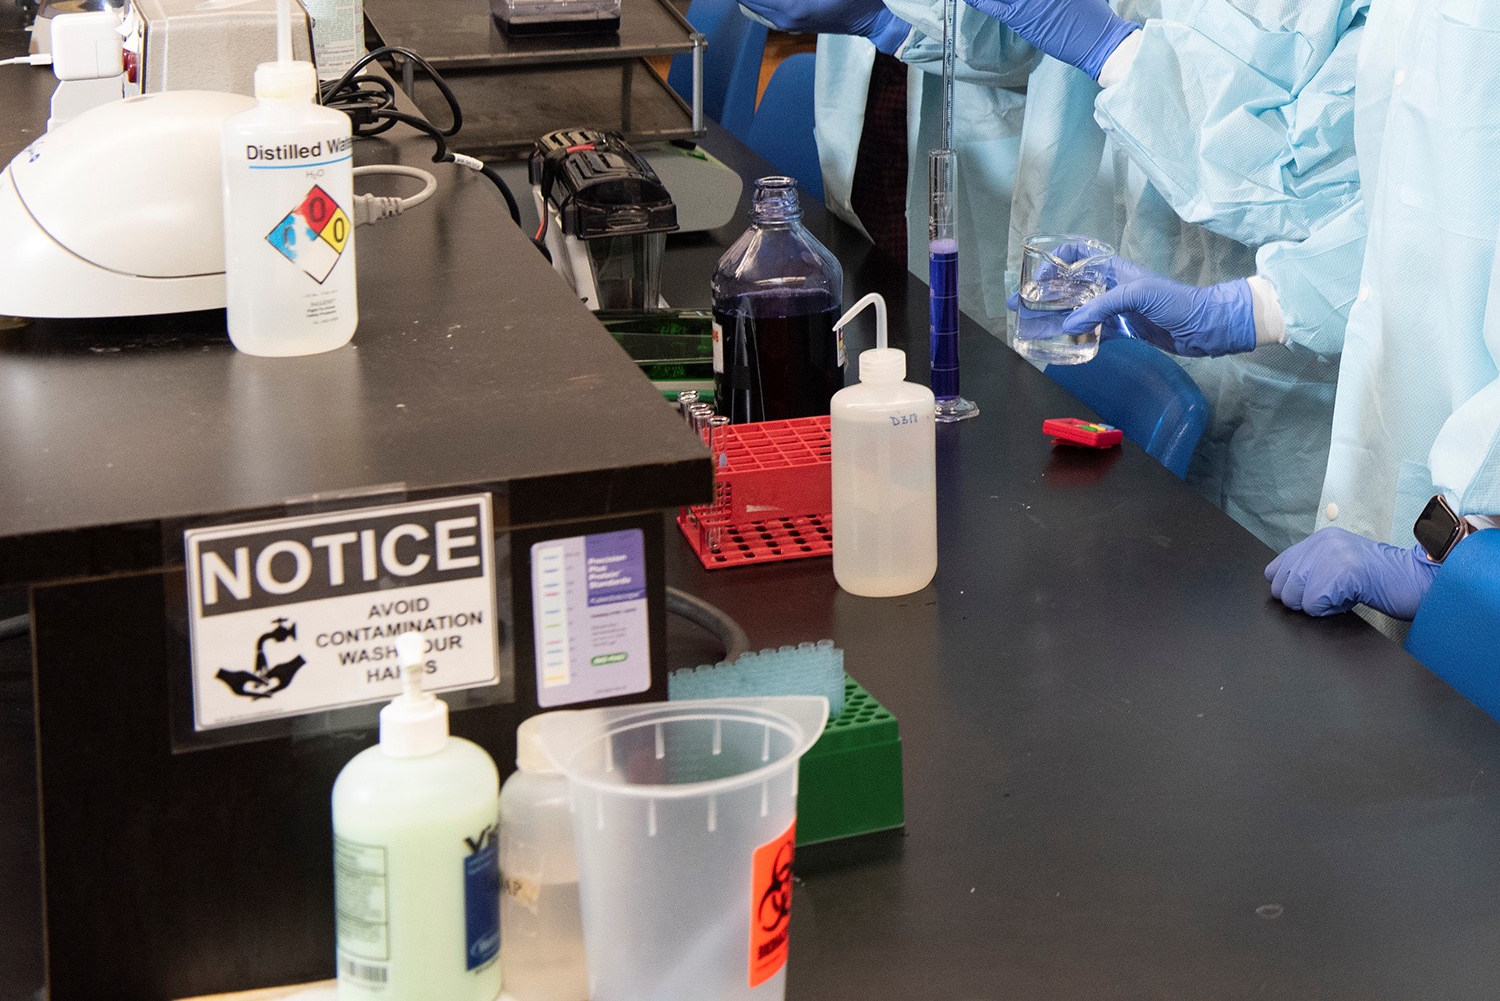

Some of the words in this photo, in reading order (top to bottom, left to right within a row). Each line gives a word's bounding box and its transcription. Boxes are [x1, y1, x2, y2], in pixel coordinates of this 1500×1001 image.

[246, 141, 321, 160] Distilled
[309, 197, 325, 223] 0
[333, 217, 345, 243] 0
[201, 516, 481, 606] NOTICE
[367, 597, 430, 619] AVOID
[315, 611, 484, 648] CONTAMINATION
[338, 646, 399, 666] WASH
[423, 635, 463, 655] OUR
[367, 659, 438, 684] HAS
